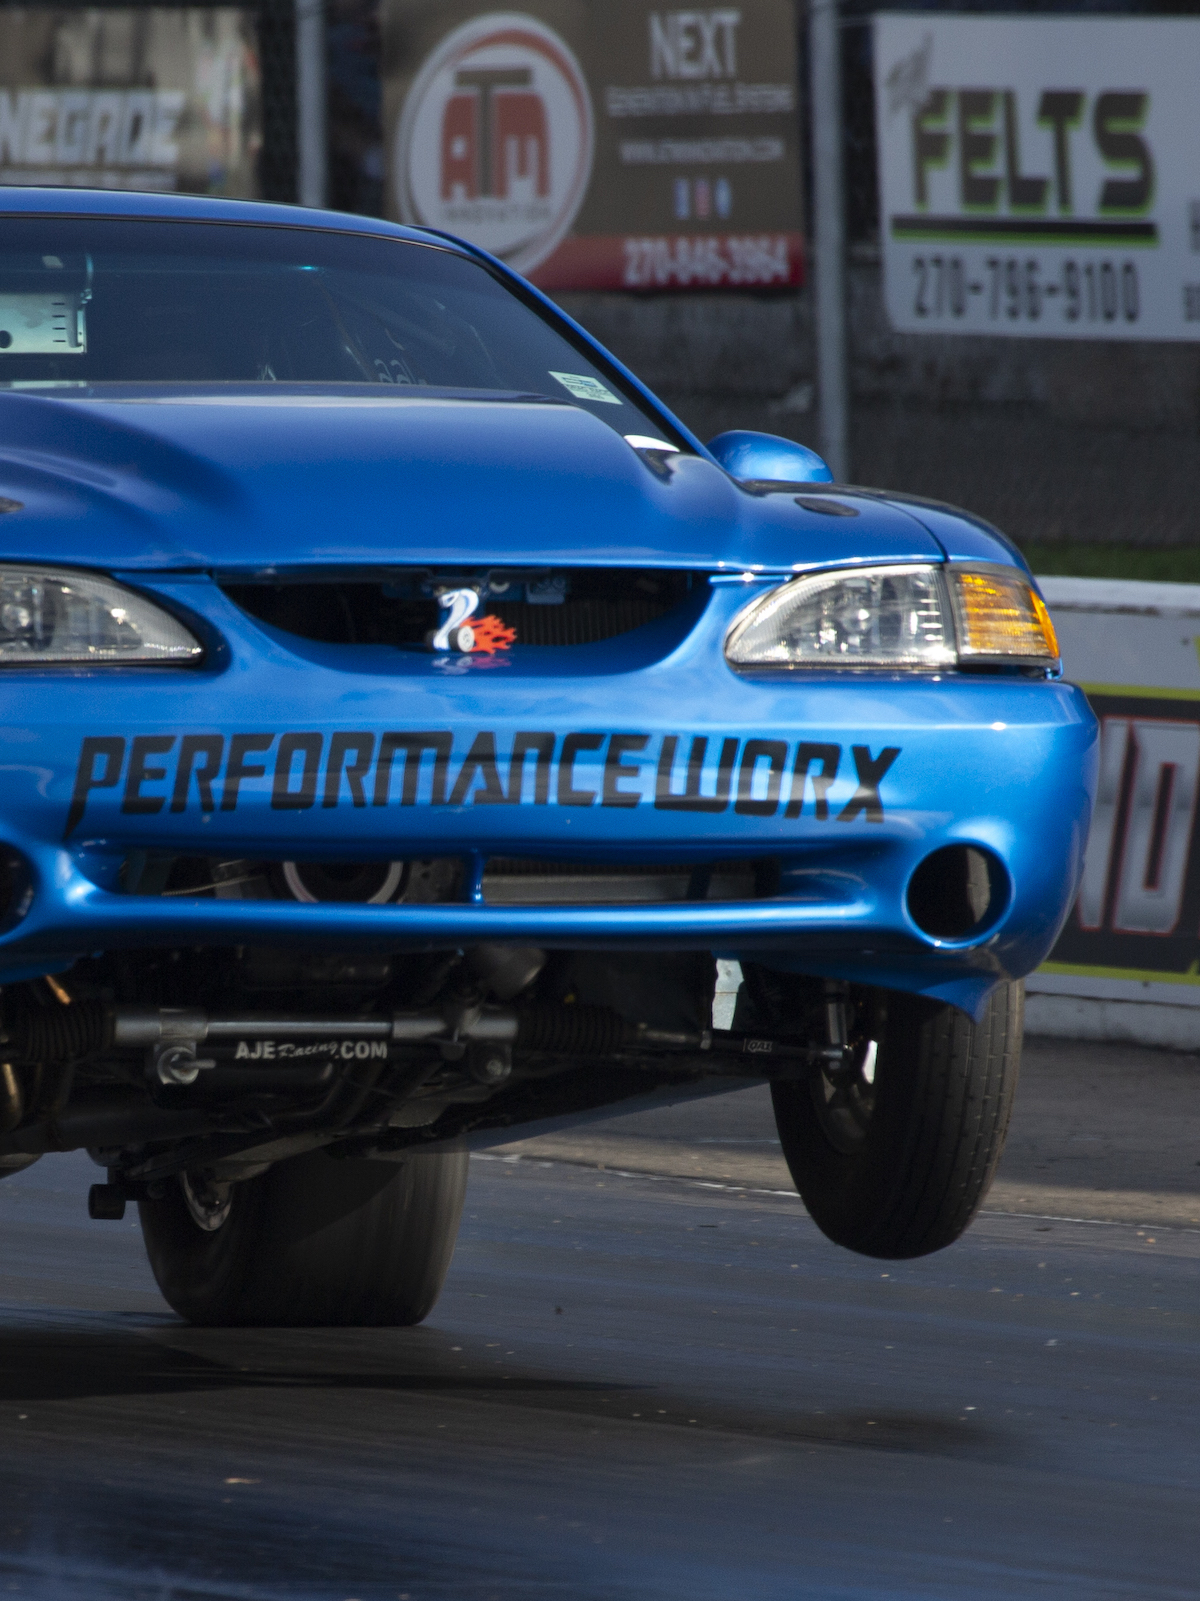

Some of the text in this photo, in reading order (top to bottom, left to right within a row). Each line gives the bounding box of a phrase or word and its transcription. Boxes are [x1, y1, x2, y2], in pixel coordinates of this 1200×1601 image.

[649, 9, 741, 79] NEXT
[910, 86, 1156, 216] FELTS
[912, 256, 1140, 323] 270-796-9100
[64, 731, 902, 840] PERFORMANCEWORX
